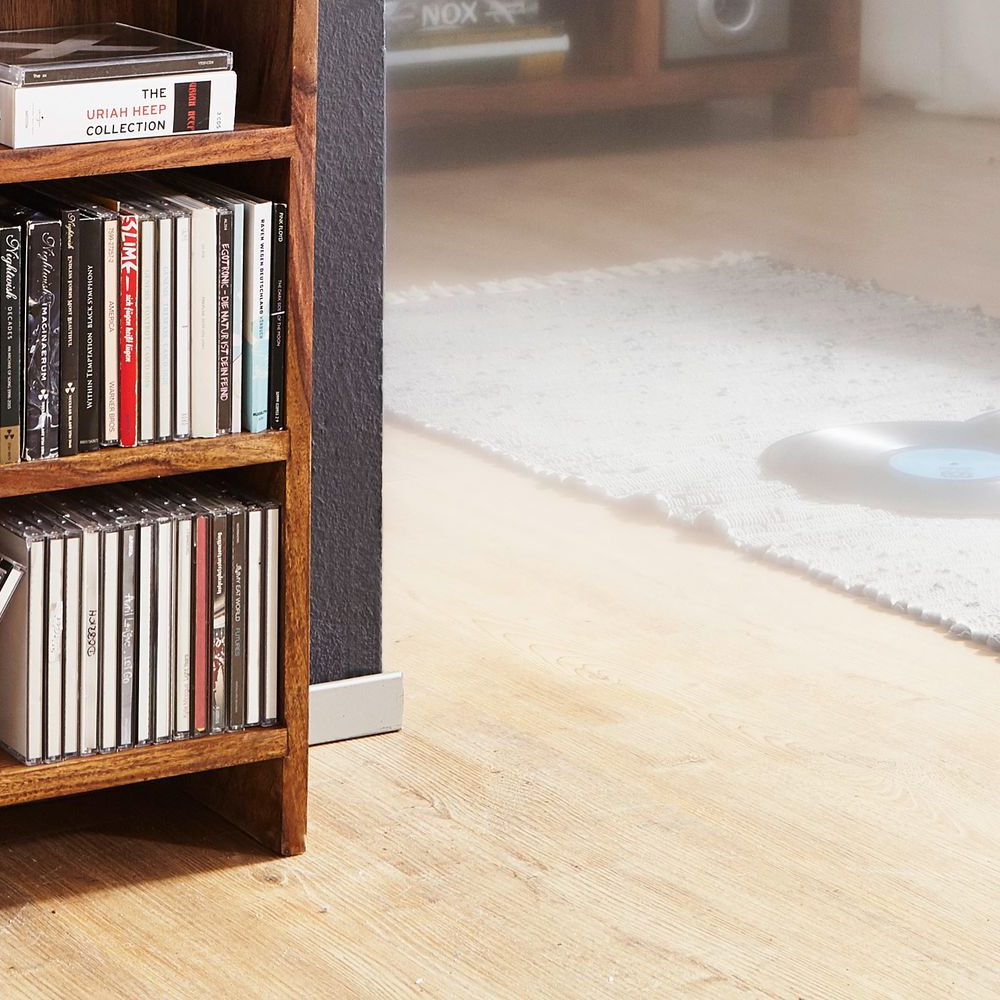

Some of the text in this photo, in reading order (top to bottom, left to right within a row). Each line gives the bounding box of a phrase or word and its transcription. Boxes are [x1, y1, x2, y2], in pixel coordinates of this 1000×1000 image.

[86, 104, 167, 121] URIAH HEEP
[142, 87, 167, 100] THE
[86, 120, 166, 137] COLLECTION
[65, 212, 76, 250] Nightwish
[0, 234, 20, 300] Nightwish
[38, 232, 55, 297] Nightwish
[220, 243, 229, 401] EGOTRONIC DIE NATUR IST DEIN FEIND
